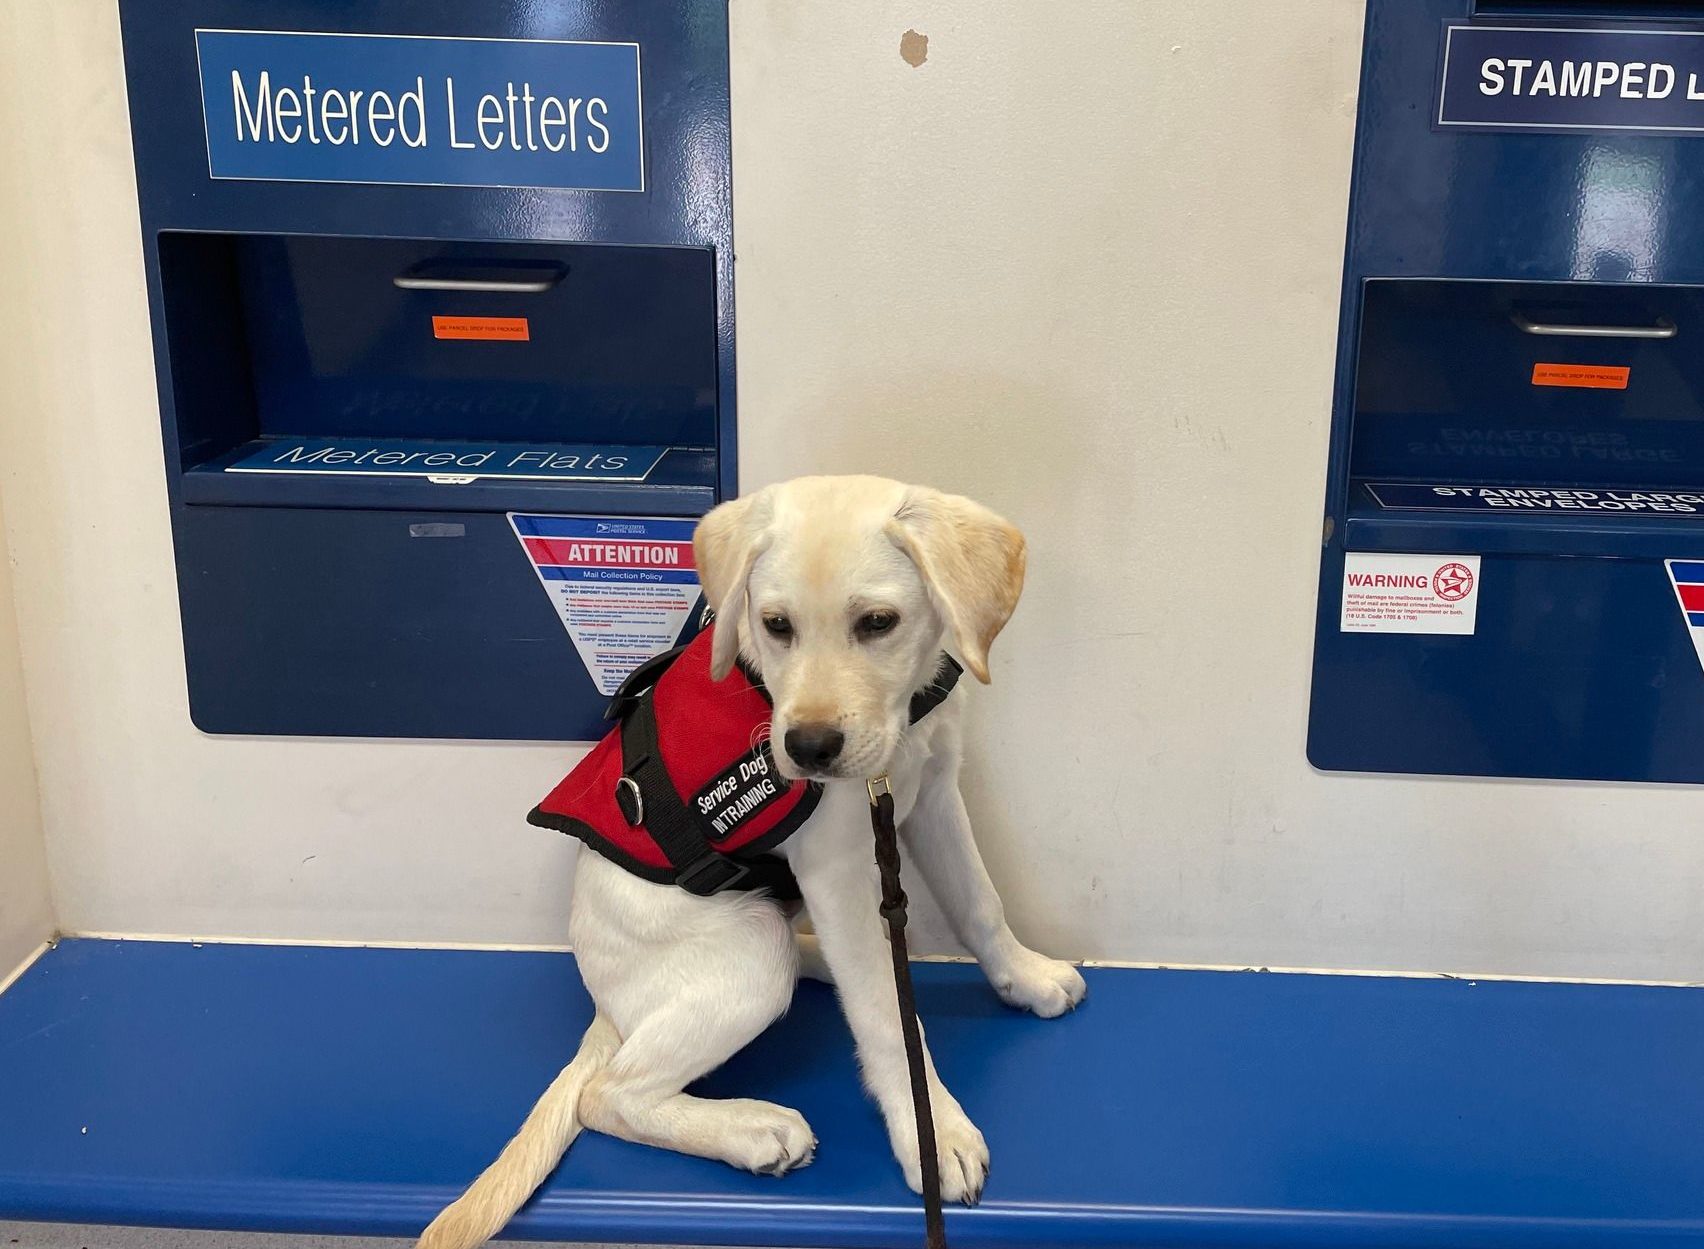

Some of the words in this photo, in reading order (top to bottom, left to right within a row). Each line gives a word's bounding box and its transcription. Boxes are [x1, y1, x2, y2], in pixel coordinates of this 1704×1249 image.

[1479, 58, 1676, 99] STAMPED
[232, 70, 426, 147] Metered
[447, 76, 610, 153] Letters
[273, 446, 496, 467] Metered
[506, 451, 629, 470] Flats
[1432, 487, 1598, 500] STAMPED
[1606, 491, 1704, 504] LARG
[1484, 497, 1697, 512] ENVELOPES
[568, 544, 678, 565] ATTENTION
[601, 571, 638, 580] Collection
[640, 572, 663, 582] Policy
[1348, 573, 1428, 588] WARNING
[697, 775, 738, 815] Service
[739, 755, 768, 782] Dog
